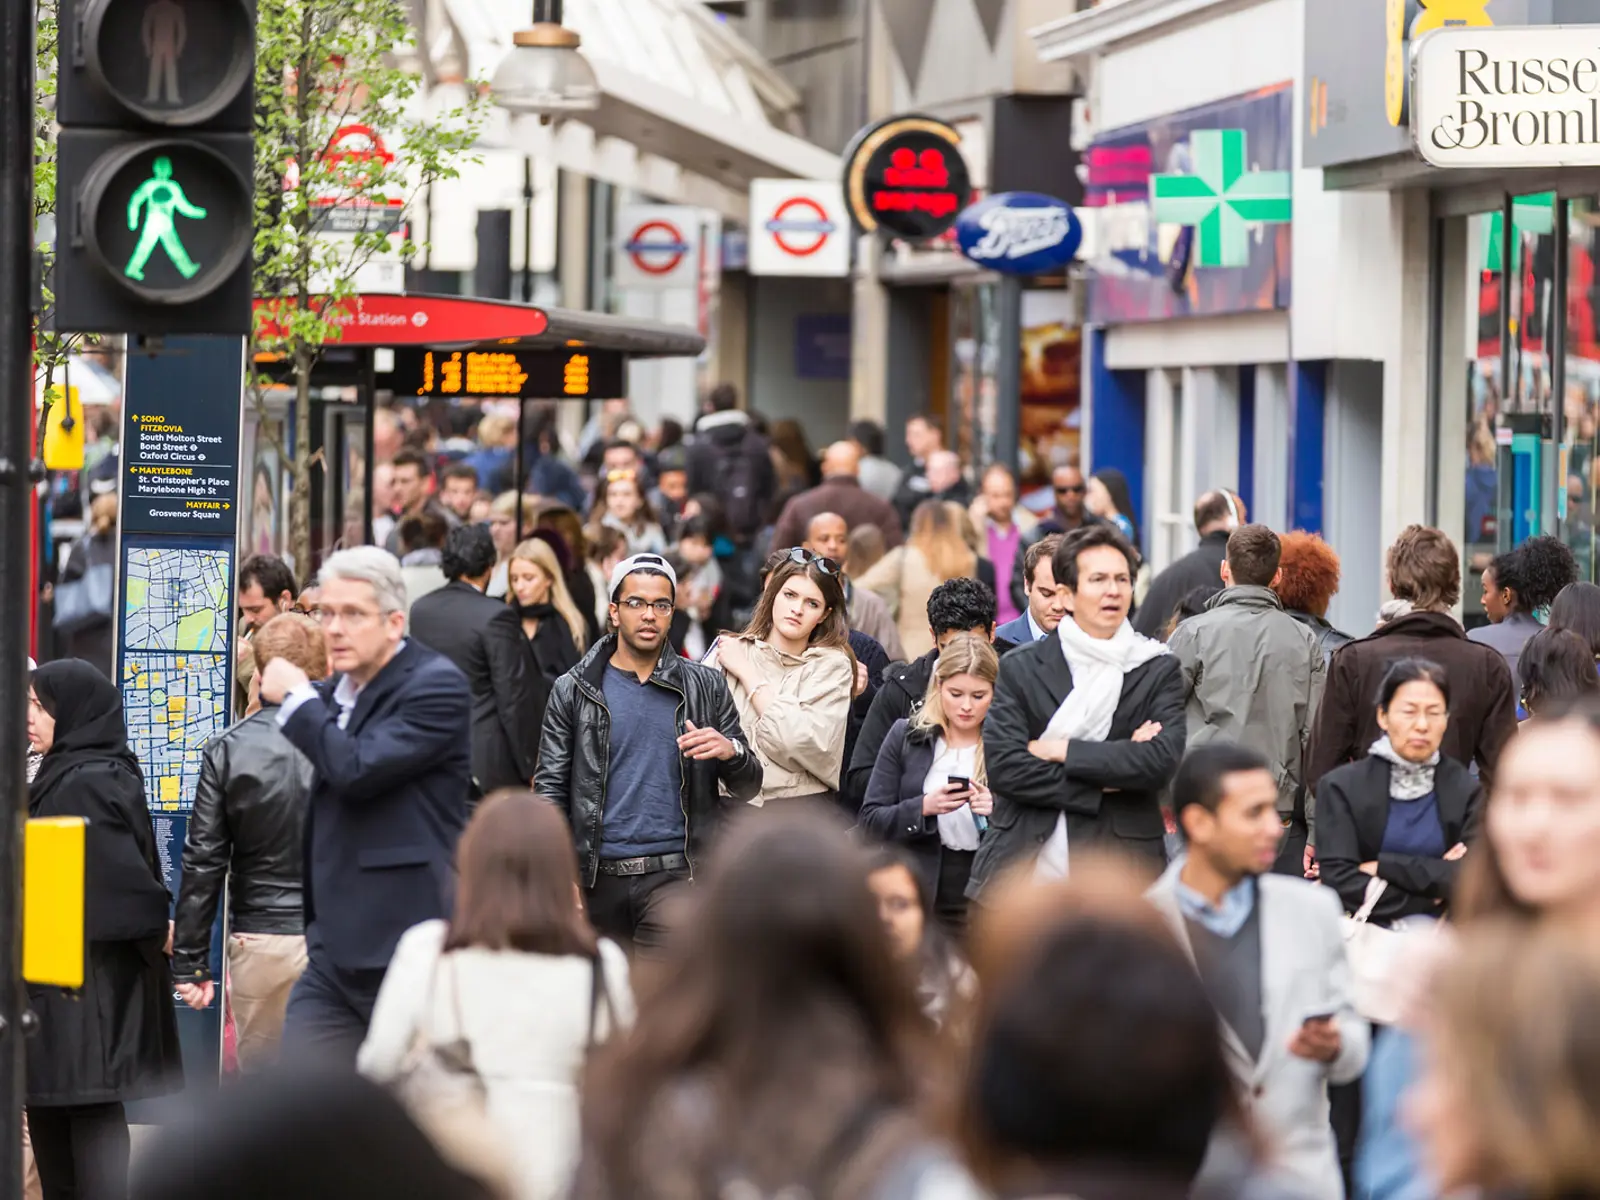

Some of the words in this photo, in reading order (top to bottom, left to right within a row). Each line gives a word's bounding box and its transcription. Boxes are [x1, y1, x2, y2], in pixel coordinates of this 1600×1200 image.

[1455, 46, 1600, 96] Russe
[357, 313, 407, 325] Station
[141, 415, 165, 423] SOHO
[140, 424, 183, 433] FITZROVIA
[140, 433, 164, 442] South
[166, 434, 195, 443] Molton
[197, 435, 222, 443] Street
[140, 442, 161, 451] Bond
[163, 443, 188, 452] Street
[140, 452, 168, 460] Oxford
[170, 453, 196, 461] Circus
[139, 467, 193, 475] MARYLEBONE
[138, 475, 150, 483] St.
[152, 476, 206, 486] Christopher's
[208, 478, 230, 486] Place
[138, 485, 186, 494] Marylebone
[187, 487, 206, 496] High
[207, 487, 217, 495] St
[149, 509, 191, 518] Grosvenor
[192, 511, 220, 519] Square
